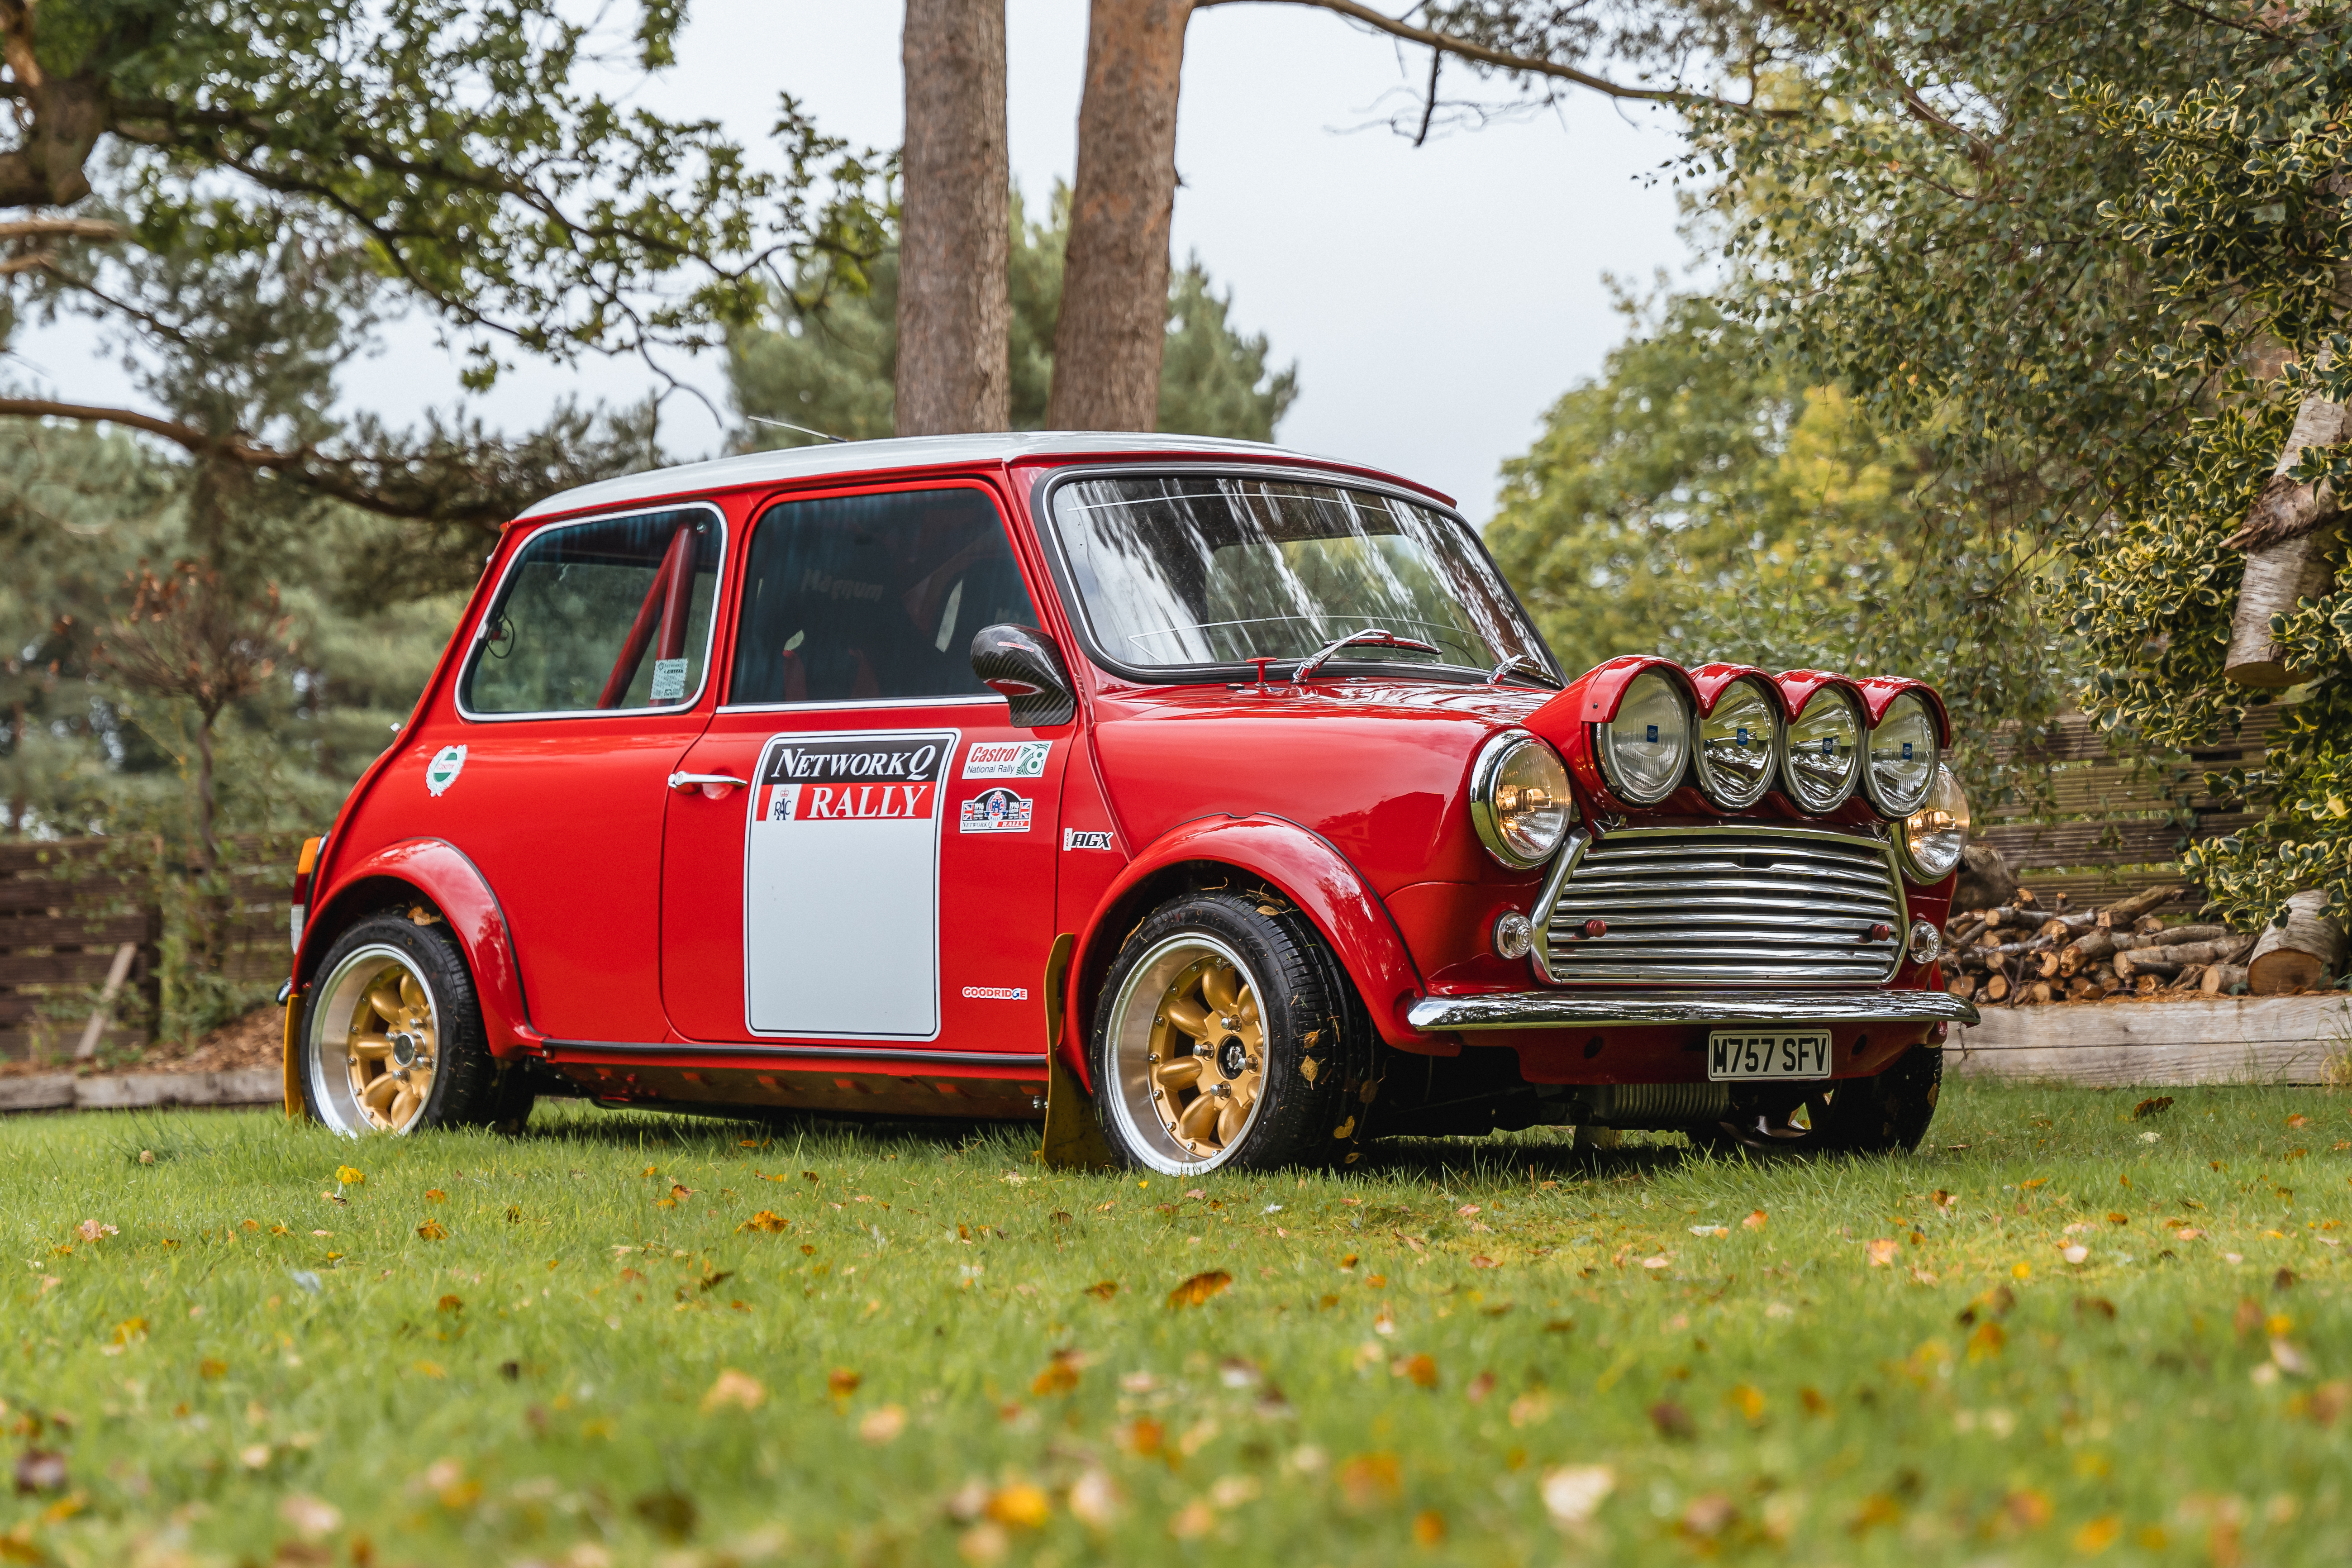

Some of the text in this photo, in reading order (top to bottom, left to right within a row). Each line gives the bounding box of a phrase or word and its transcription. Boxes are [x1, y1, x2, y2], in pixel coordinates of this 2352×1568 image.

[971, 746, 1021, 763] Castrol
[967, 765, 1015, 774] National Rally
[774, 798, 791, 821] RAC
[807, 786, 928, 818] RALLY
[1071, 834, 1111, 848] AGX
[964, 988, 1026, 998] GOODRIDGE
[1713, 1038, 1827, 1073] M757 SFV
